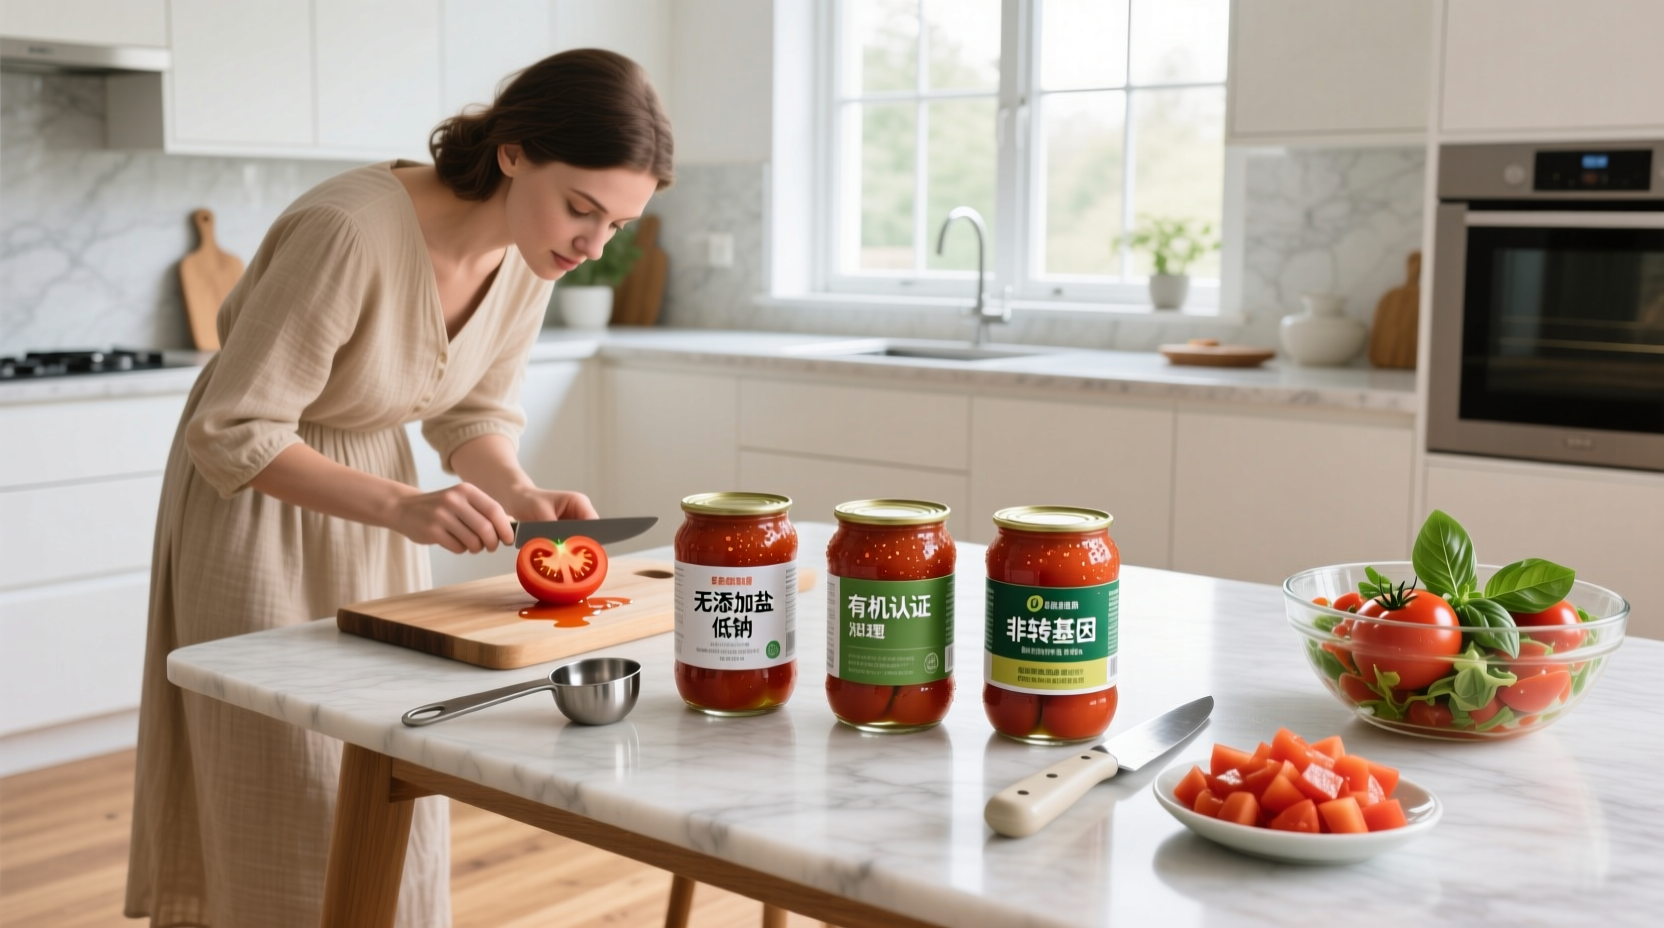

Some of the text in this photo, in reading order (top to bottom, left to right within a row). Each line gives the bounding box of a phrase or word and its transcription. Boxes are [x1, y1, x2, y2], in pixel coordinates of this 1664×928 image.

[694, 590, 774, 613] 无添加盐
[848, 594, 931, 619] 有机认证
[712, 615, 753, 639] 低钠
[1006, 616, 1096, 643] 非转基因
